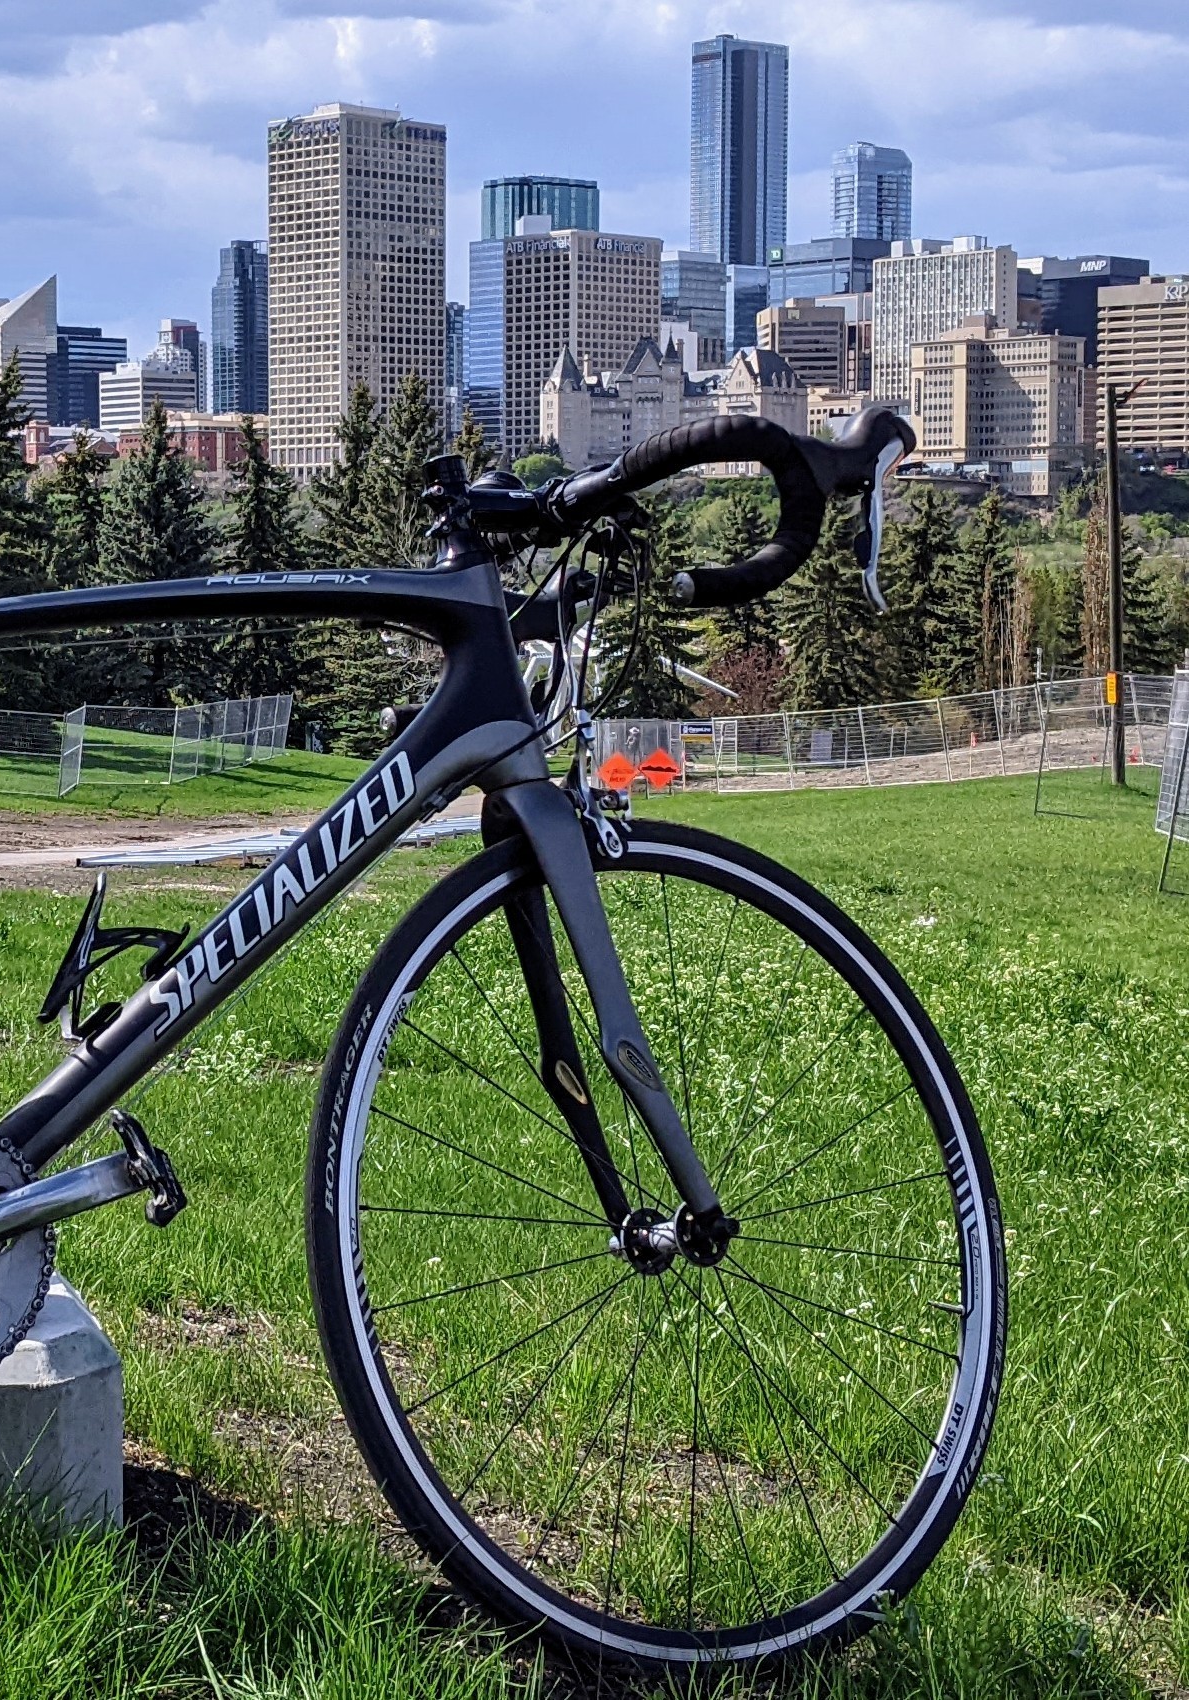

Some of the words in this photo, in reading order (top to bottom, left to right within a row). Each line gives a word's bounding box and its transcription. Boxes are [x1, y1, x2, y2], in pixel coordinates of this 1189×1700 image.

[506, 241, 524, 253] ATB
[596, 237, 613, 250] ATB
[1080, 260, 1107, 273] MNP
[206, 574, 372, 586] ROUBAIX
[149, 750, 416, 1040] SPECIALIZED
[377, 1037, 389, 1063] DT
[387, 998, 408, 1036] SWISS
[325, 1003, 373, 1217] BONTRAGER
[951, 1402, 965, 1428] DT
[937, 1427, 957, 1467] SWISS
